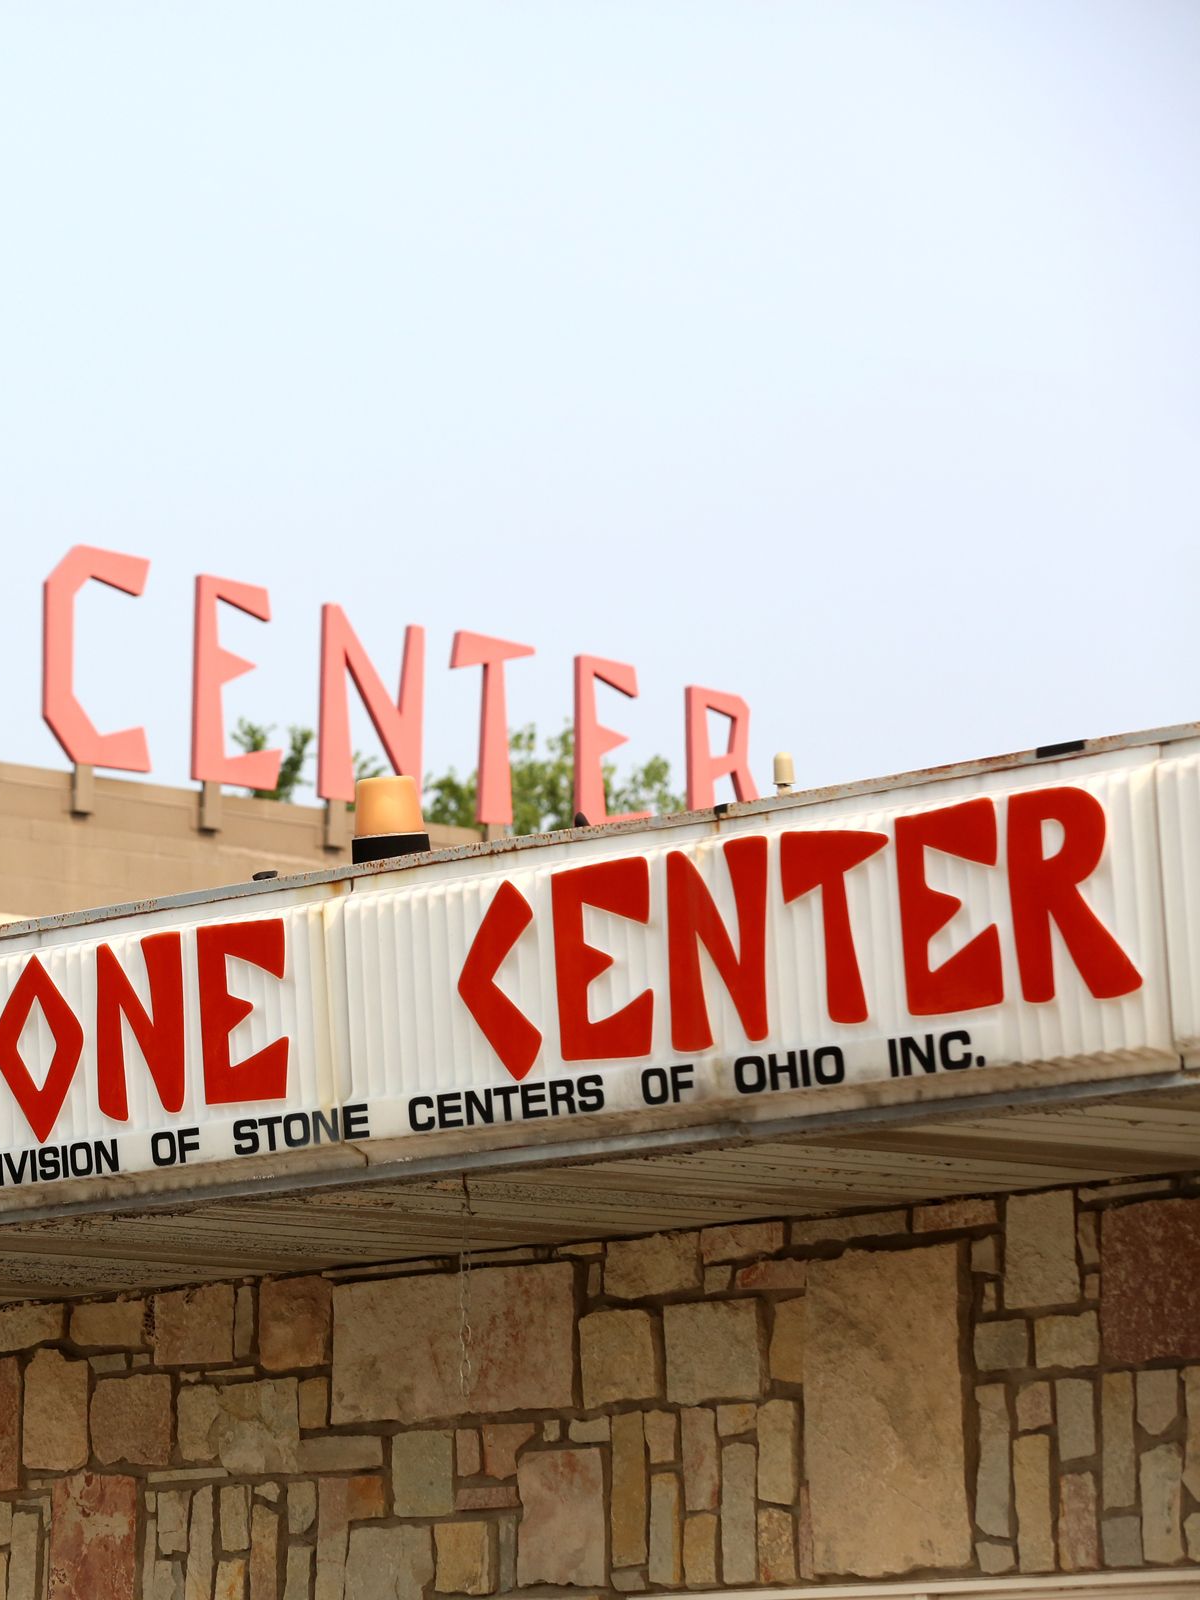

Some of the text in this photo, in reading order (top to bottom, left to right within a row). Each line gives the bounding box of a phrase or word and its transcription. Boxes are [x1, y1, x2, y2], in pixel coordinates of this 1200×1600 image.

[42, 544, 759, 824] CENTER
[457, 786, 1144, 1081] CENTER
[150, 1127, 200, 1167] OF
[233, 1103, 370, 1156] STONE
[408, 1074, 605, 1132] CENTERS
[640, 1063, 695, 1107] OF
[734, 1045, 846, 1094] OHIO
[887, 1029, 987, 1078] INC.
